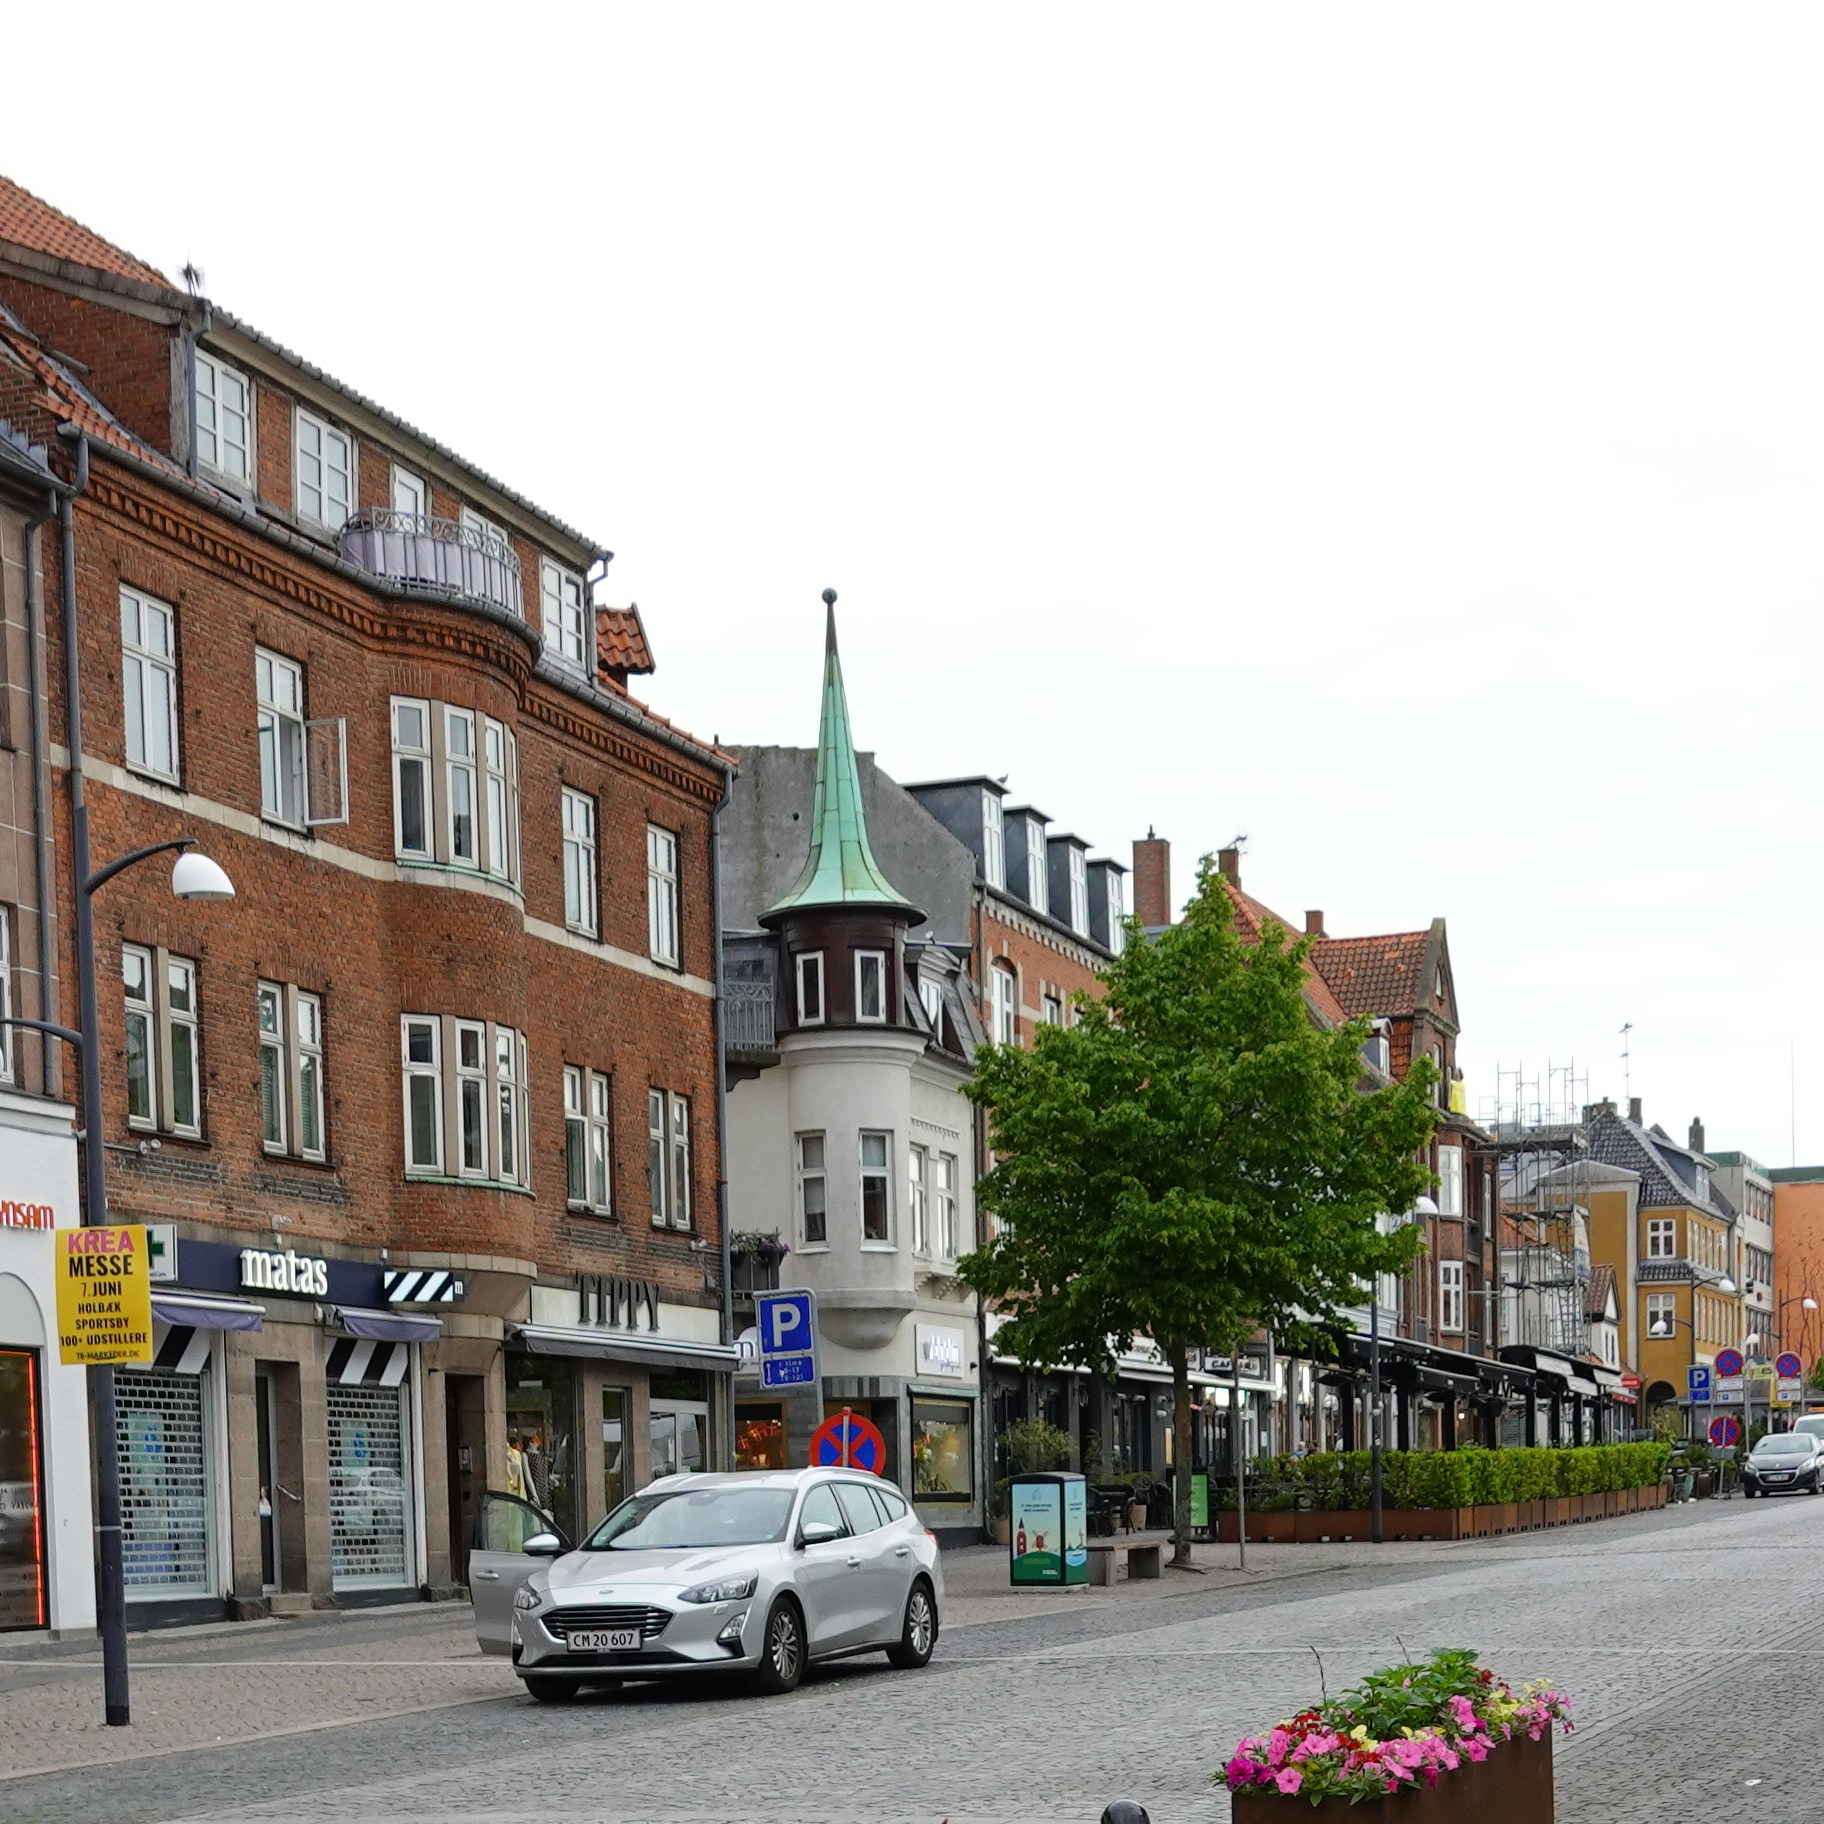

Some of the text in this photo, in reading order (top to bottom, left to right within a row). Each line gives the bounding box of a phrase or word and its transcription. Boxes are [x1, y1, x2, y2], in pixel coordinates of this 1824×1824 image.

[67, 1230, 135, 1254] KREA
[69, 1254, 133, 1278] MESSE
[240, 1249, 328, 1296] matas
[78, 1302, 121, 1314] HOLBÆK
[76, 1317, 129, 1330] SPORTSBY
[86, 1332, 147, 1346] UDSTILLERE
[573, 1632, 634, 1647] CM 20 607
